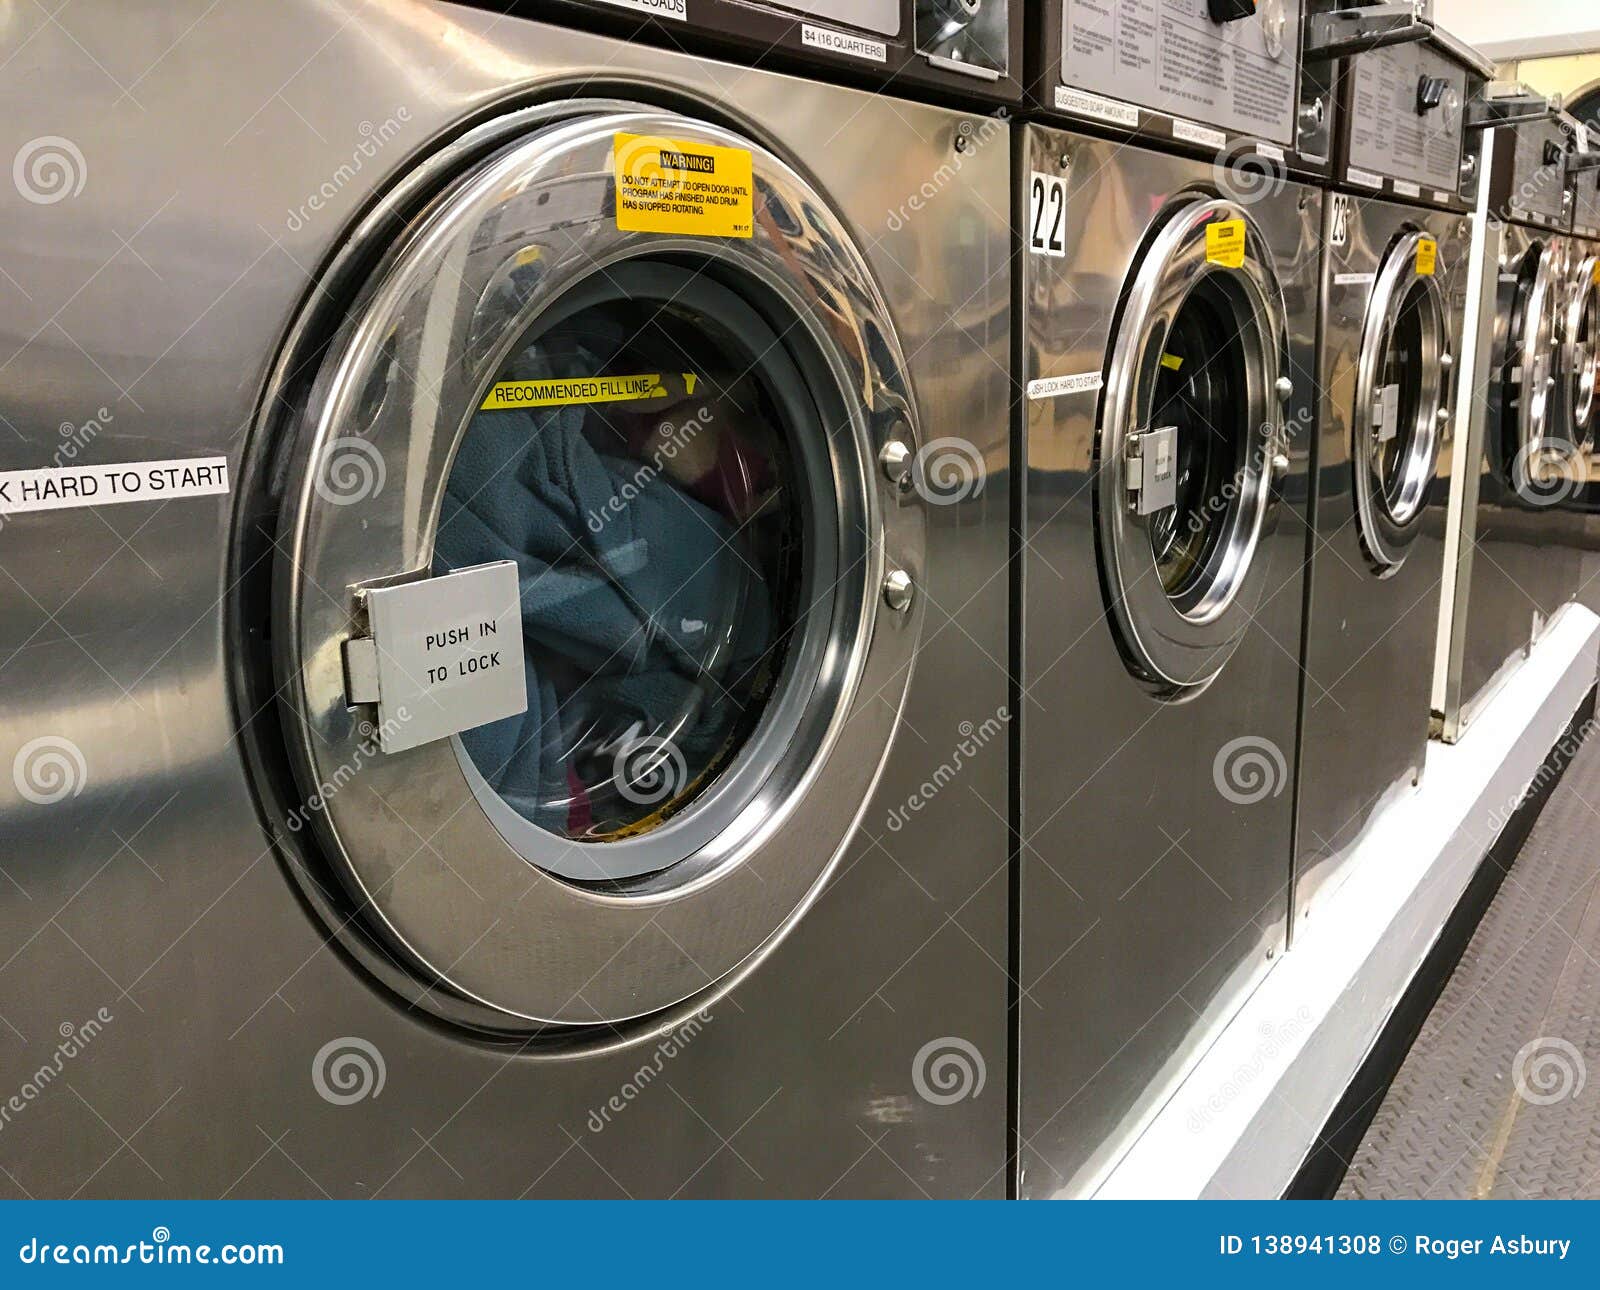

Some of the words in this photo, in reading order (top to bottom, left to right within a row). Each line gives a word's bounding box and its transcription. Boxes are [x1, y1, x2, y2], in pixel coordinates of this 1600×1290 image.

[643, 0, 685, 13] ADS
[804, 31, 816, 42] $4
[818, 32, 832, 47] (16
[834, 37, 885, 59] QUARTERS)
[661, 153, 714, 171] WARNING!
[622, 175, 633, 185] DO
[634, 176, 648, 186] NOT
[650, 178, 680, 189] ATTEMPT
[683, 181, 691, 190] TO
[692, 182, 710, 192] OPEN
[711, 184, 730, 193] DOOR
[731, 186, 748, 196] UNTIL
[622, 188, 658, 199] PROGRAM
[660, 191, 674, 200] HAS
[675, 192, 704, 203] FINISHED
[706, 195, 718, 205] AND
[720, 197, 738, 206] DRUM
[622, 200, 638, 210] HAS
[639, 201, 670, 213] STOPPED
[672, 204, 705, 215] ROTATING.
[1033, 177, 1063, 251] 22
[1332, 196, 1346, 241] 23
[495, 383, 598, 402] RECOMMENDED
[601, 381, 624, 396] FILL
[626, 379, 650, 394] LINE
[1045, 382, 1059, 393] LOCK
[1060, 378, 1075, 390] HARD
[1076, 377, 1083, 388] TO
[1084, 374, 1101, 387] START
[21, 474, 98, 501] HARD
[105, 472, 141, 494] TO
[149, 465, 226, 491] START
[426, 627, 469, 650] PUSH
[479, 620, 497, 637] IN
[427, 666, 448, 684] TO
[459, 651, 500, 676] LOCK
